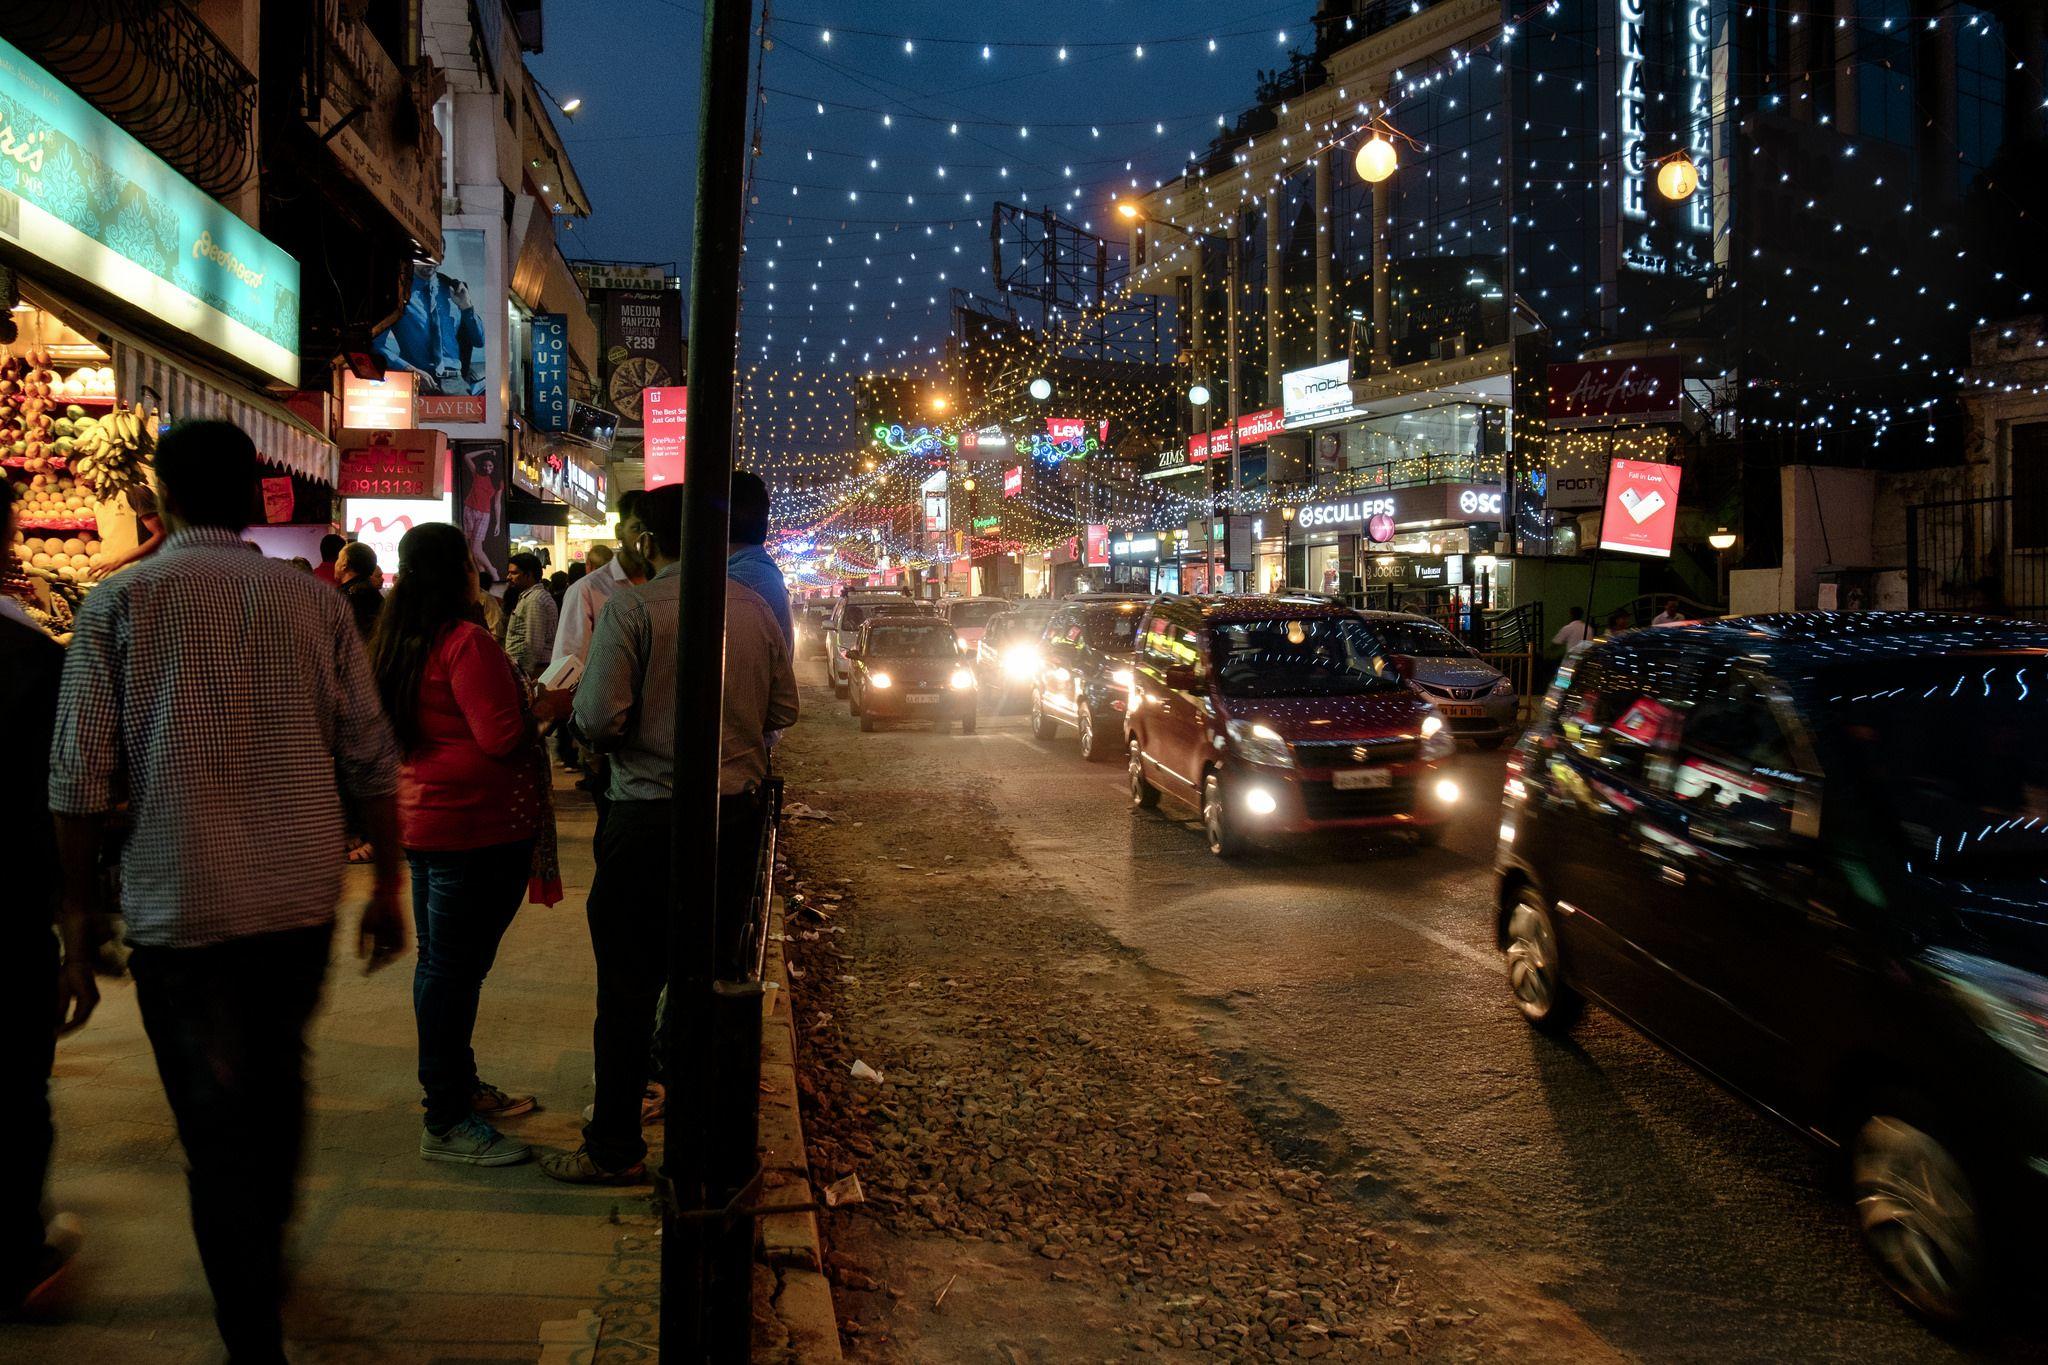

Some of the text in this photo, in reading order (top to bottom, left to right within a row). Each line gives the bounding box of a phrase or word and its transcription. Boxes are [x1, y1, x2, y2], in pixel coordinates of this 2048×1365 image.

[621, 305, 661, 317] MEDIUM
[621, 316, 661, 328] PAN PIZZA
[538, 333, 548, 402] JUTE
[551, 324, 562, 426] COTTAGE
[418, 398, 483, 415] PLAYERS
[1629, 471, 1640, 479] Fall
[1647, 474, 1662, 482] Love
[1304, 498, 1395, 525] SCULLERS
[1373, 565, 1406, 579] JOCKEY
